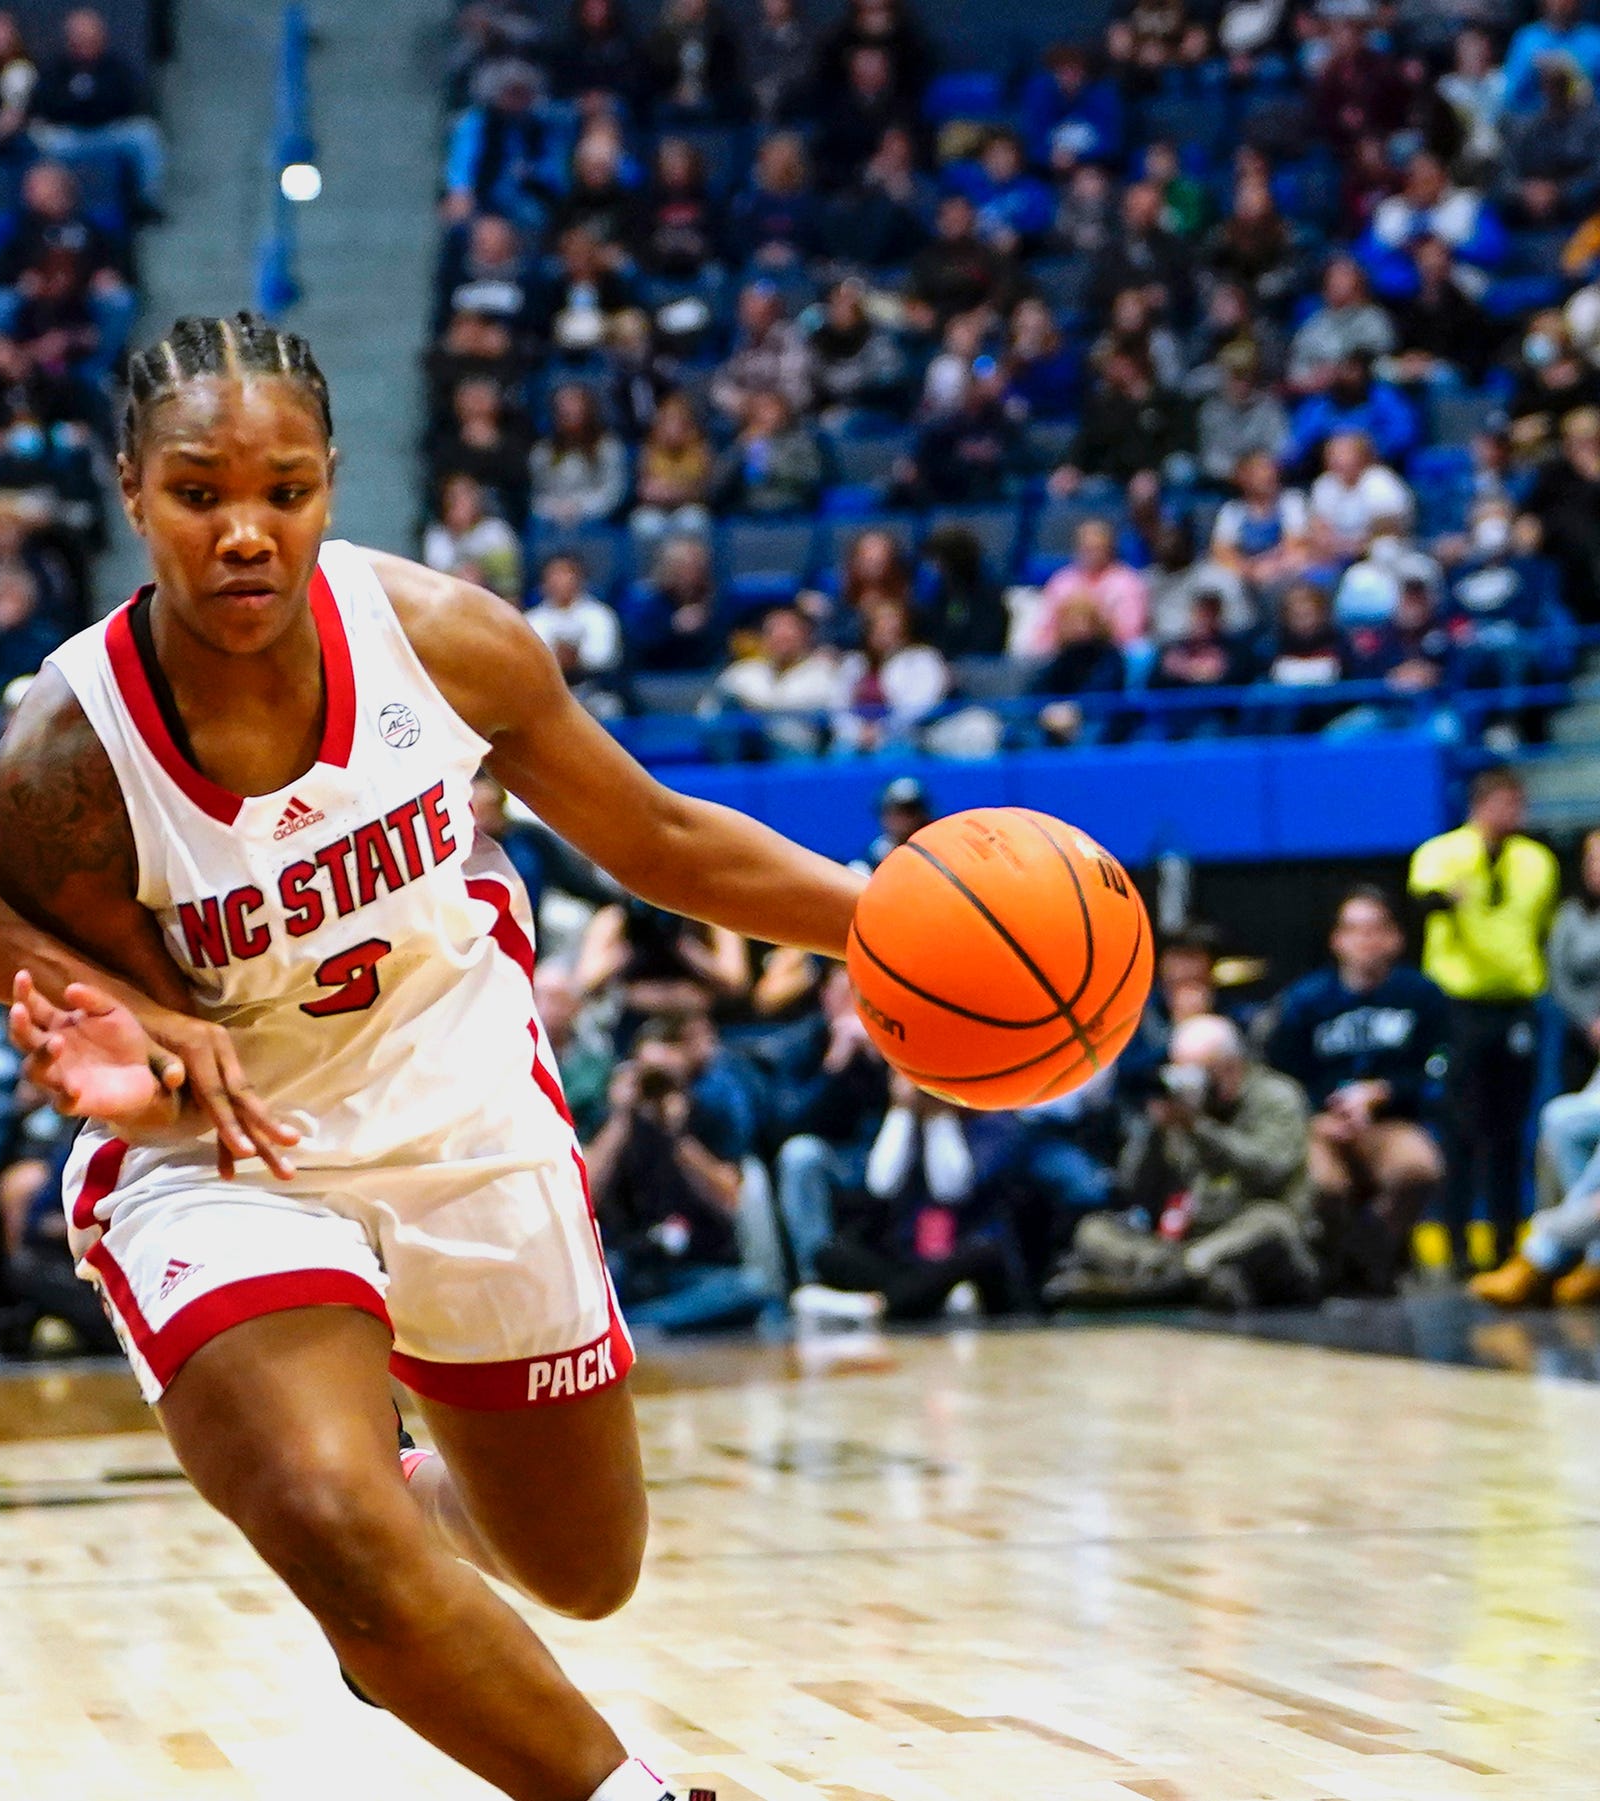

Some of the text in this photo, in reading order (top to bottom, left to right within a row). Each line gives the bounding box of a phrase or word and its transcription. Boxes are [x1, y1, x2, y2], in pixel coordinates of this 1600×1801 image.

[386, 710, 415, 735] ACC
[273, 809, 326, 841] adidas
[177, 778, 458, 969] NC STATE
[527, 1336, 617, 1401] PACK
